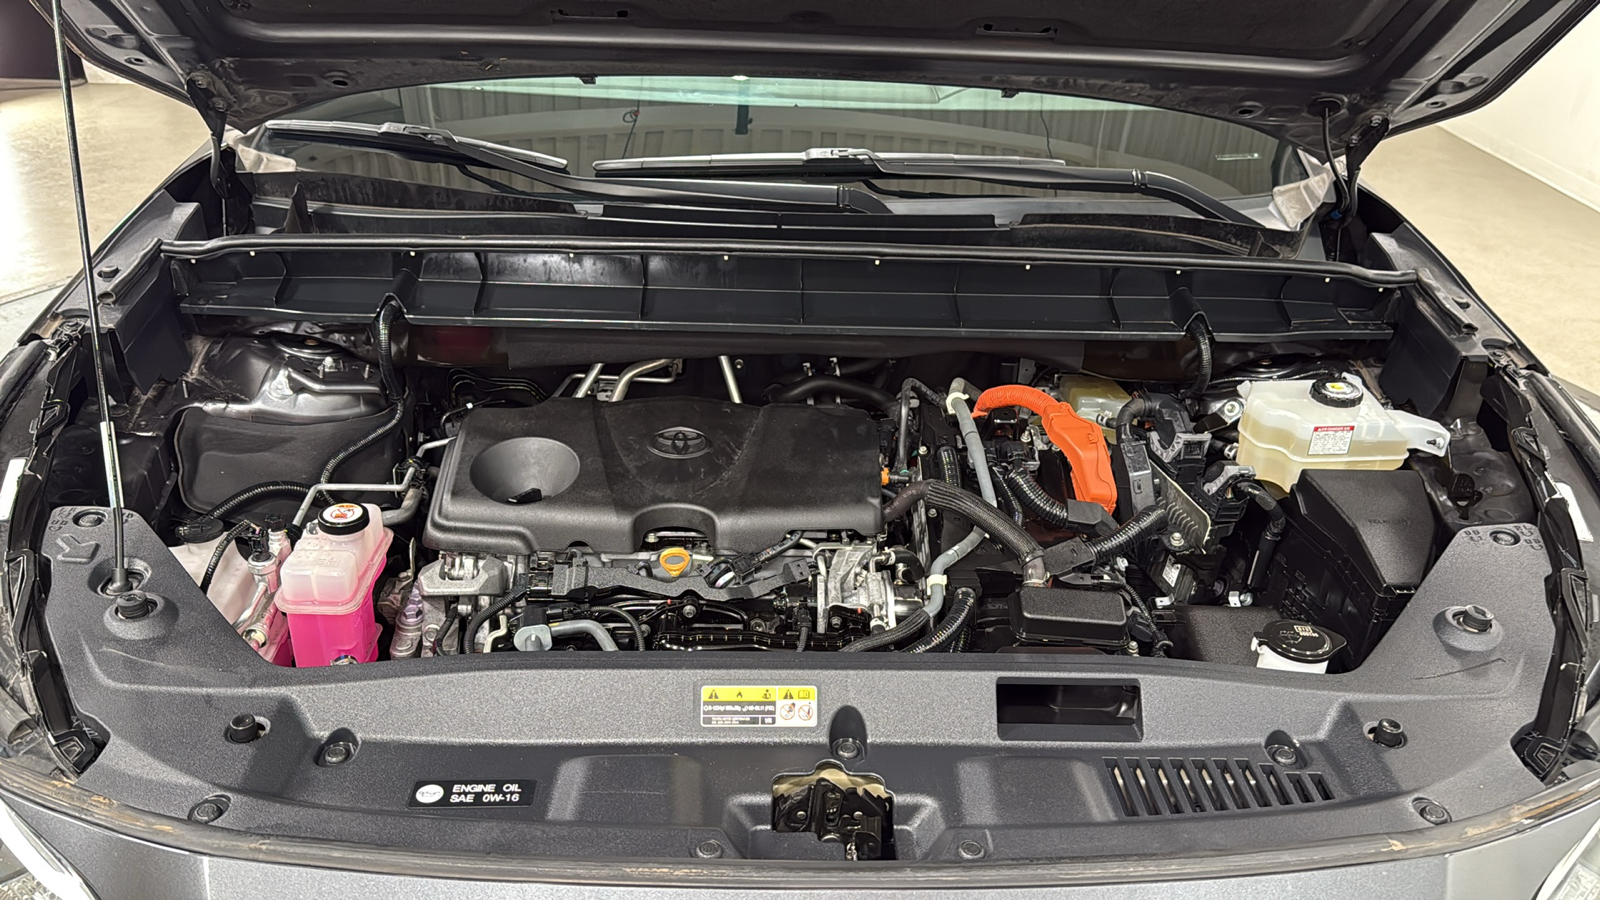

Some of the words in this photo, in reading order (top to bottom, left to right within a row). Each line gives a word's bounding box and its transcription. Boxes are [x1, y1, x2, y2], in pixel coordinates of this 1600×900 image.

[452, 784, 496, 793] ENGINE
[502, 783, 522, 792] OIL
[449, 794, 475, 803] SAE
[482, 793, 520, 803] 0W-16
